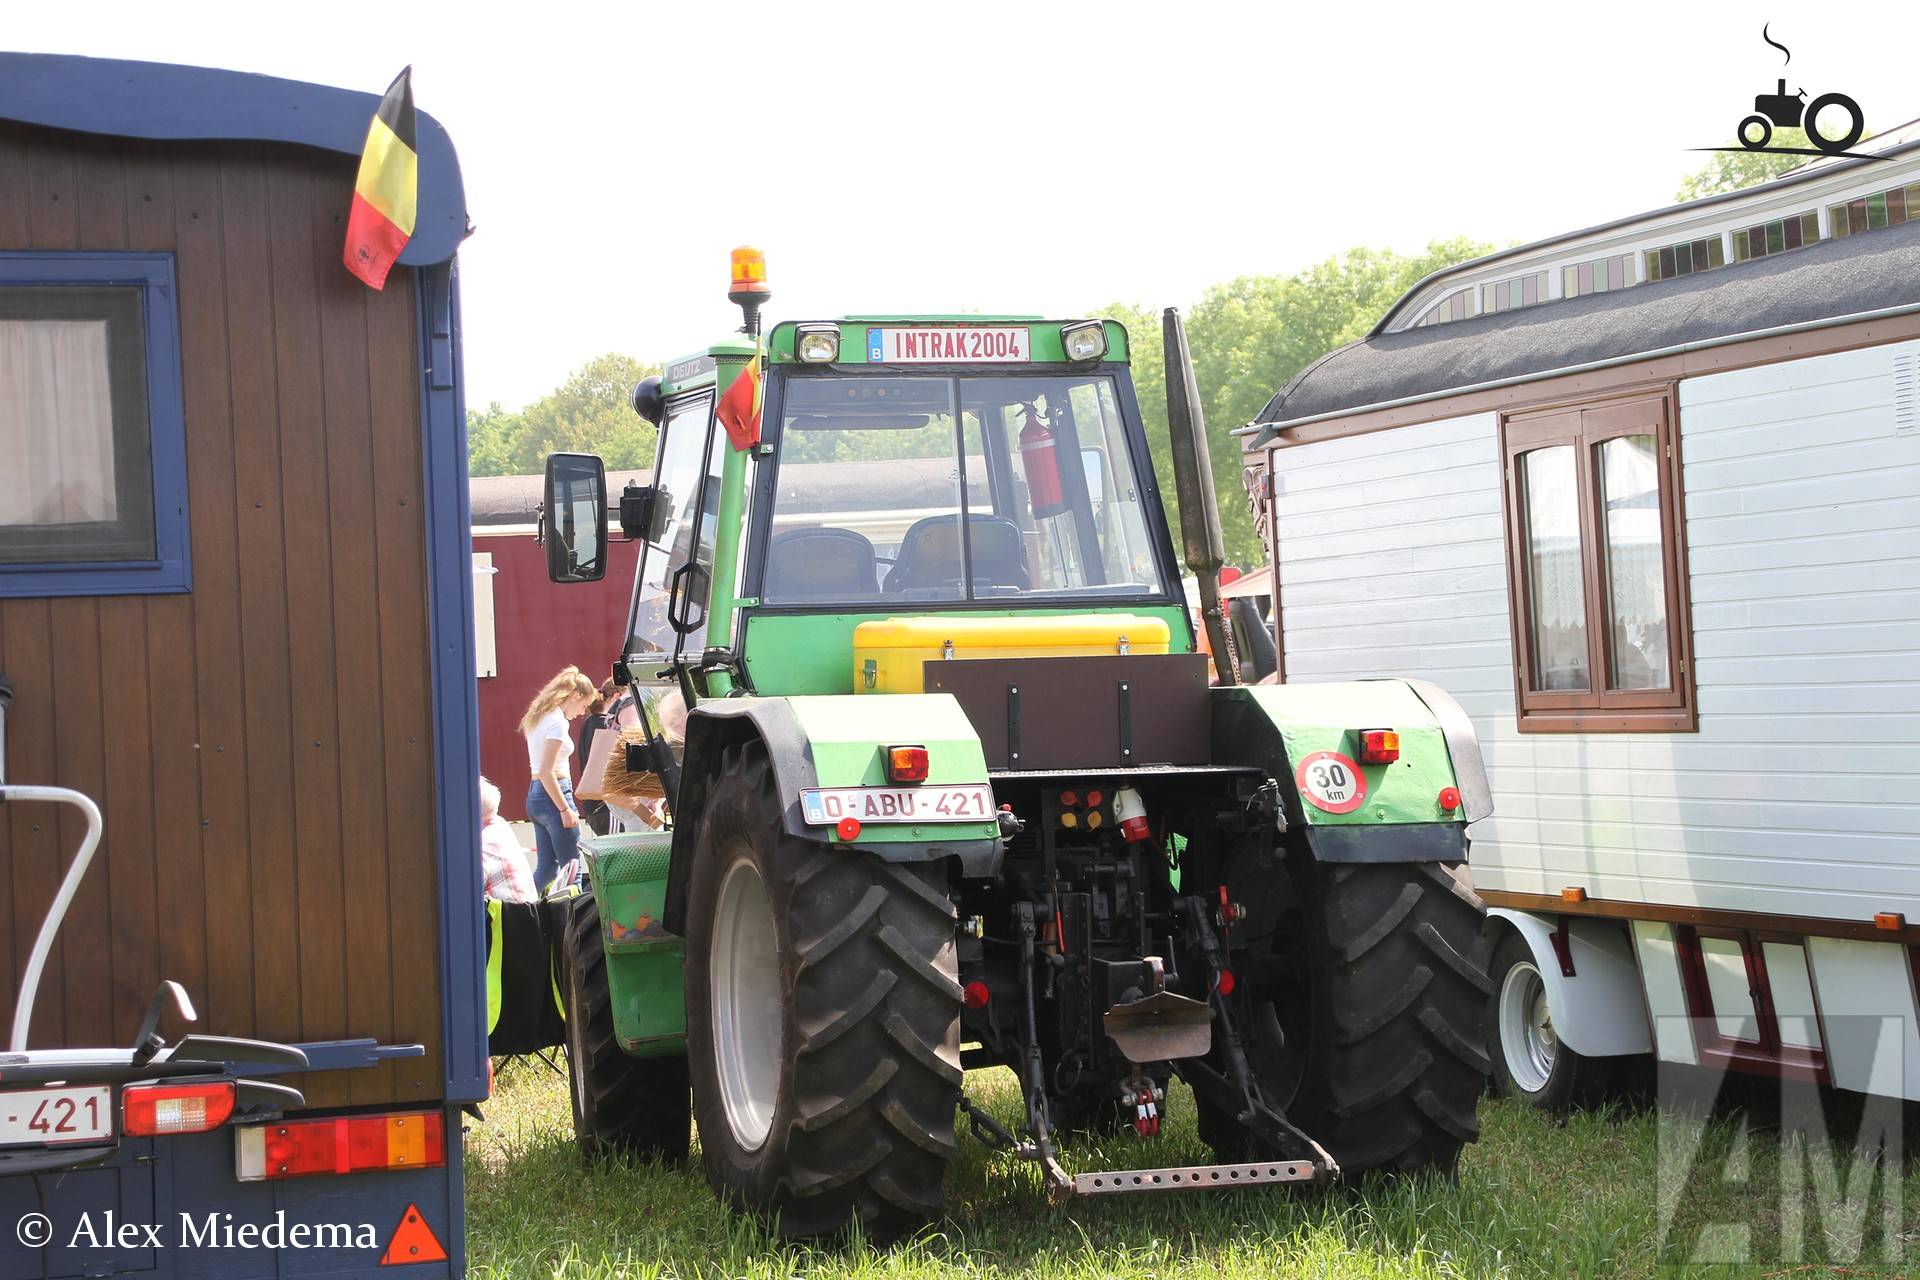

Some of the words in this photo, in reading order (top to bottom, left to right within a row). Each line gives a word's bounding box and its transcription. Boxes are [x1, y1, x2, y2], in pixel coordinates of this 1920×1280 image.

[872, 348, 881, 359] B
[896, 332, 1019, 358] INTRAK2004
[672, 360, 700, 380] DEUTZ
[1313, 764, 1346, 788] 30
[1326, 790, 1345, 801] km
